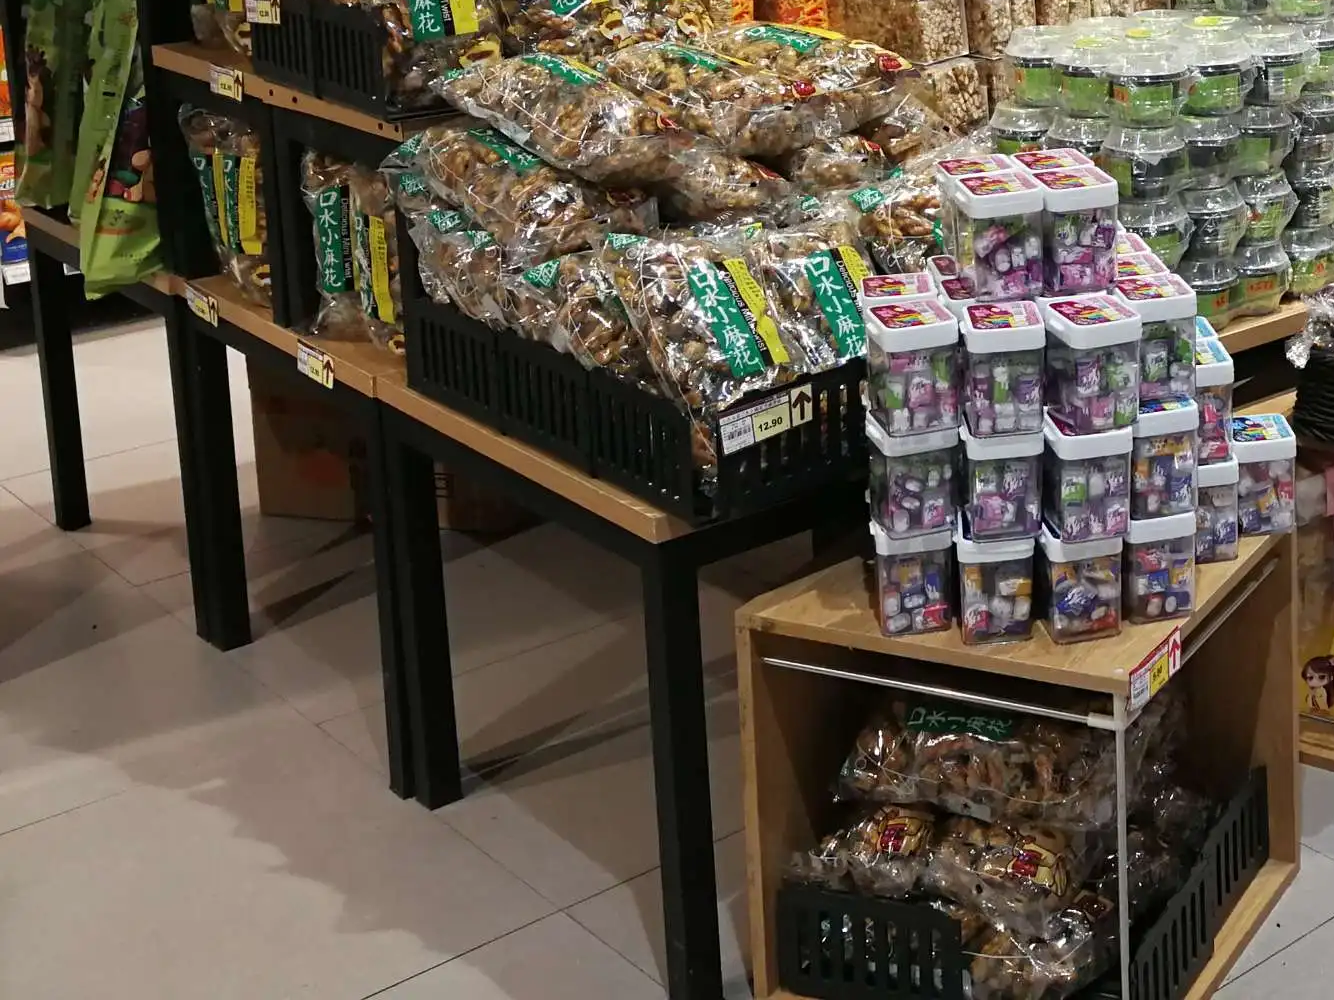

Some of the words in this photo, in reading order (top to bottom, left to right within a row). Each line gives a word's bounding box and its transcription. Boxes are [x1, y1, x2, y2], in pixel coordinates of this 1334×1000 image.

[320, 191, 343, 288] 口水小麻花
[690, 267, 760, 369] 口水小麻花
[808, 255, 866, 357] 口水小麻花
[757, 415, 784, 434] 12.90
[908, 706, 1013, 736] 口水小麻花
